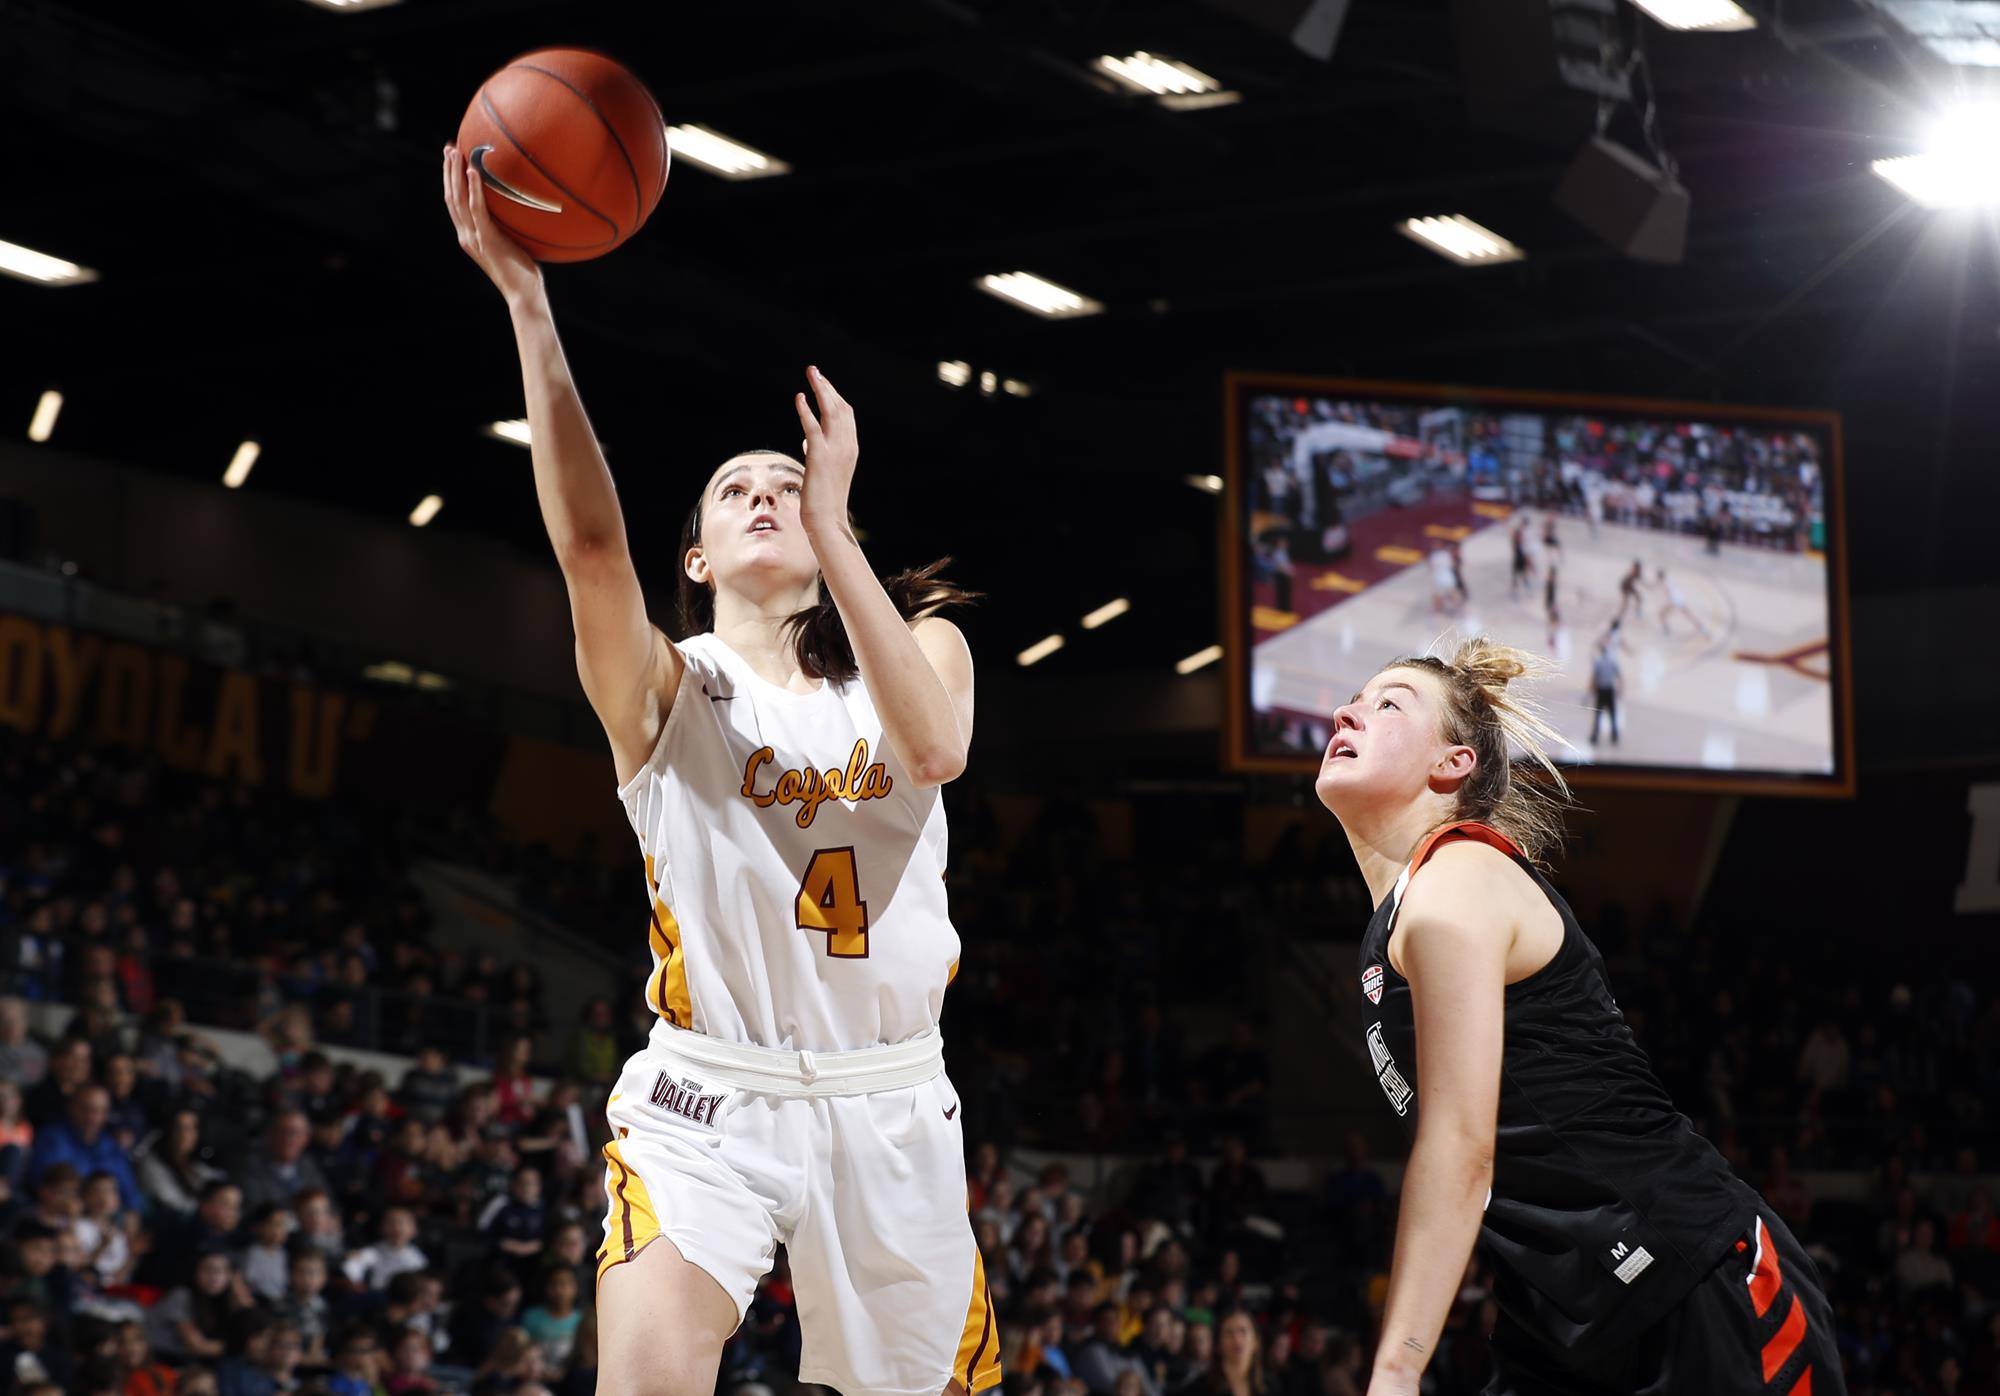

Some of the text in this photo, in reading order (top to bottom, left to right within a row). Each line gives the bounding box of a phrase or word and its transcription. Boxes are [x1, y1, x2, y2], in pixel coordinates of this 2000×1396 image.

[741, 738, 893, 828] Loyola
[795, 846, 869, 959] 4
[648, 1069, 729, 1128] VALLEY
[1610, 1241, 1629, 1261] M
